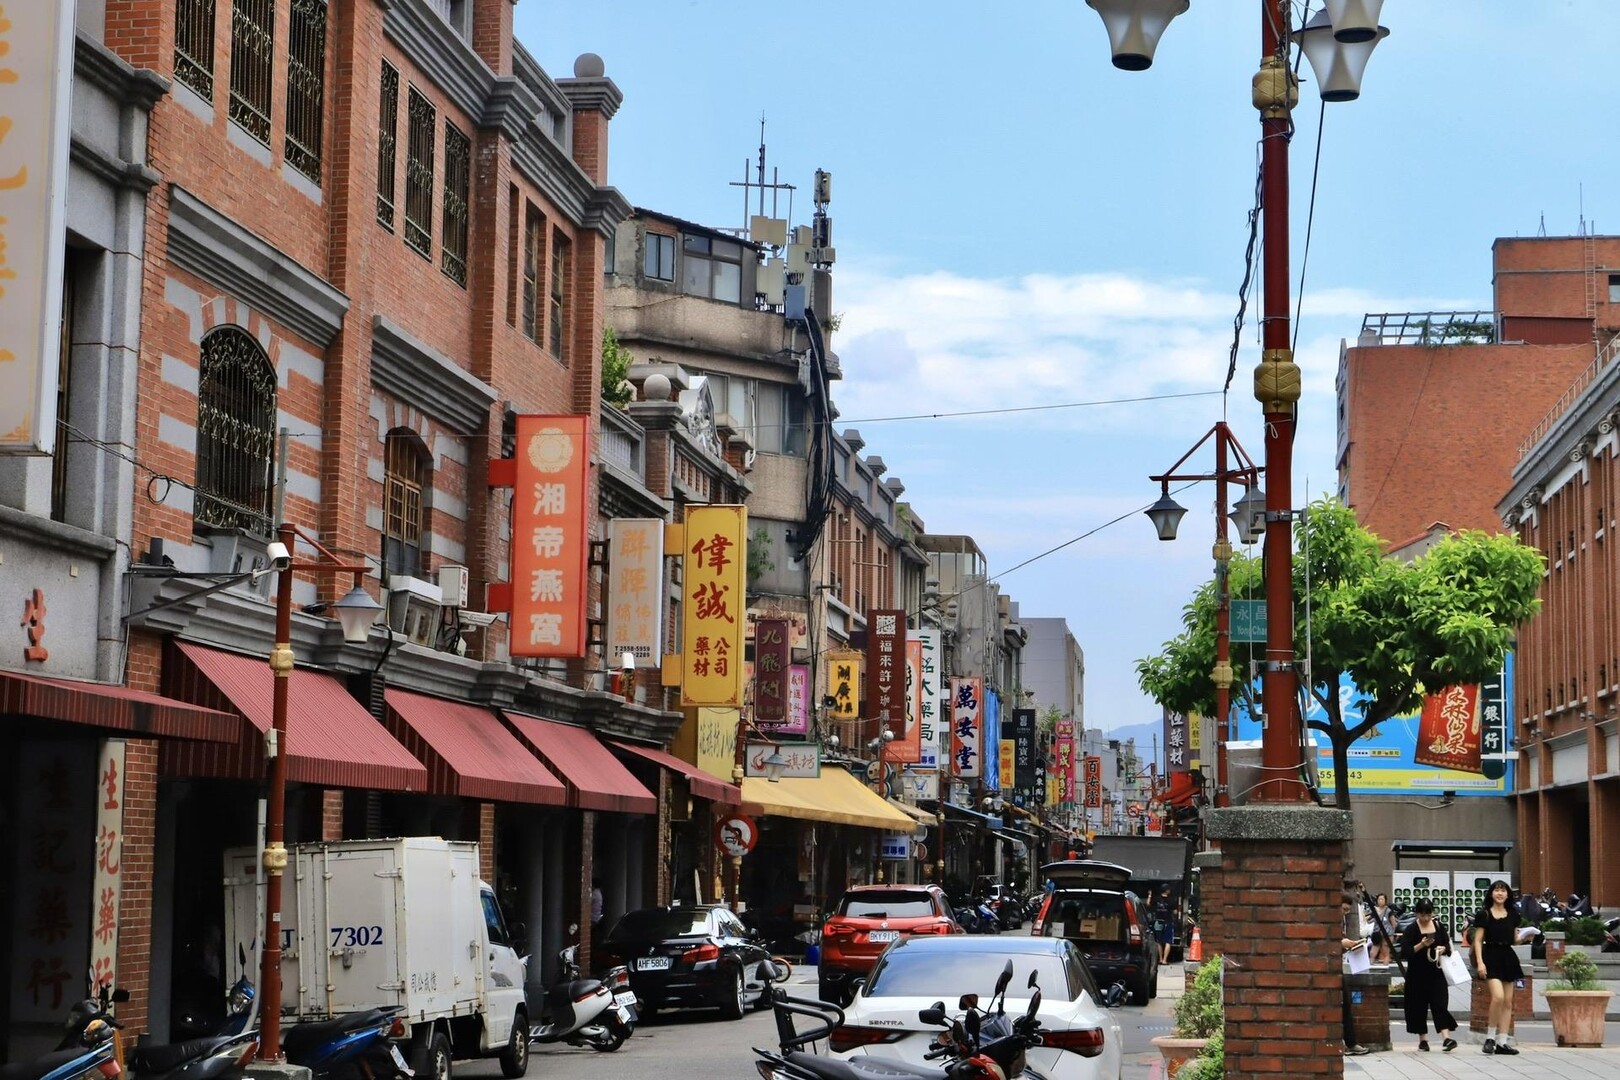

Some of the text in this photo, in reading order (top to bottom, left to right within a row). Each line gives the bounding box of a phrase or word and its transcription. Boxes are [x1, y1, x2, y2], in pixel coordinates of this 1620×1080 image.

[529, 482, 566, 645] 湘帝燕窩
[691, 534, 735, 624] 偉誠
[21, 588, 48, 662] 生
[693, 637, 710, 677] 藥材
[713, 637, 732, 677] 公司
[955, 685, 977, 770] 萬安堂
[1484, 684, 1500, 749] 一銀行
[1087, 760, 1100, 805] 百安堂
[331, 926, 383, 947] 7302
